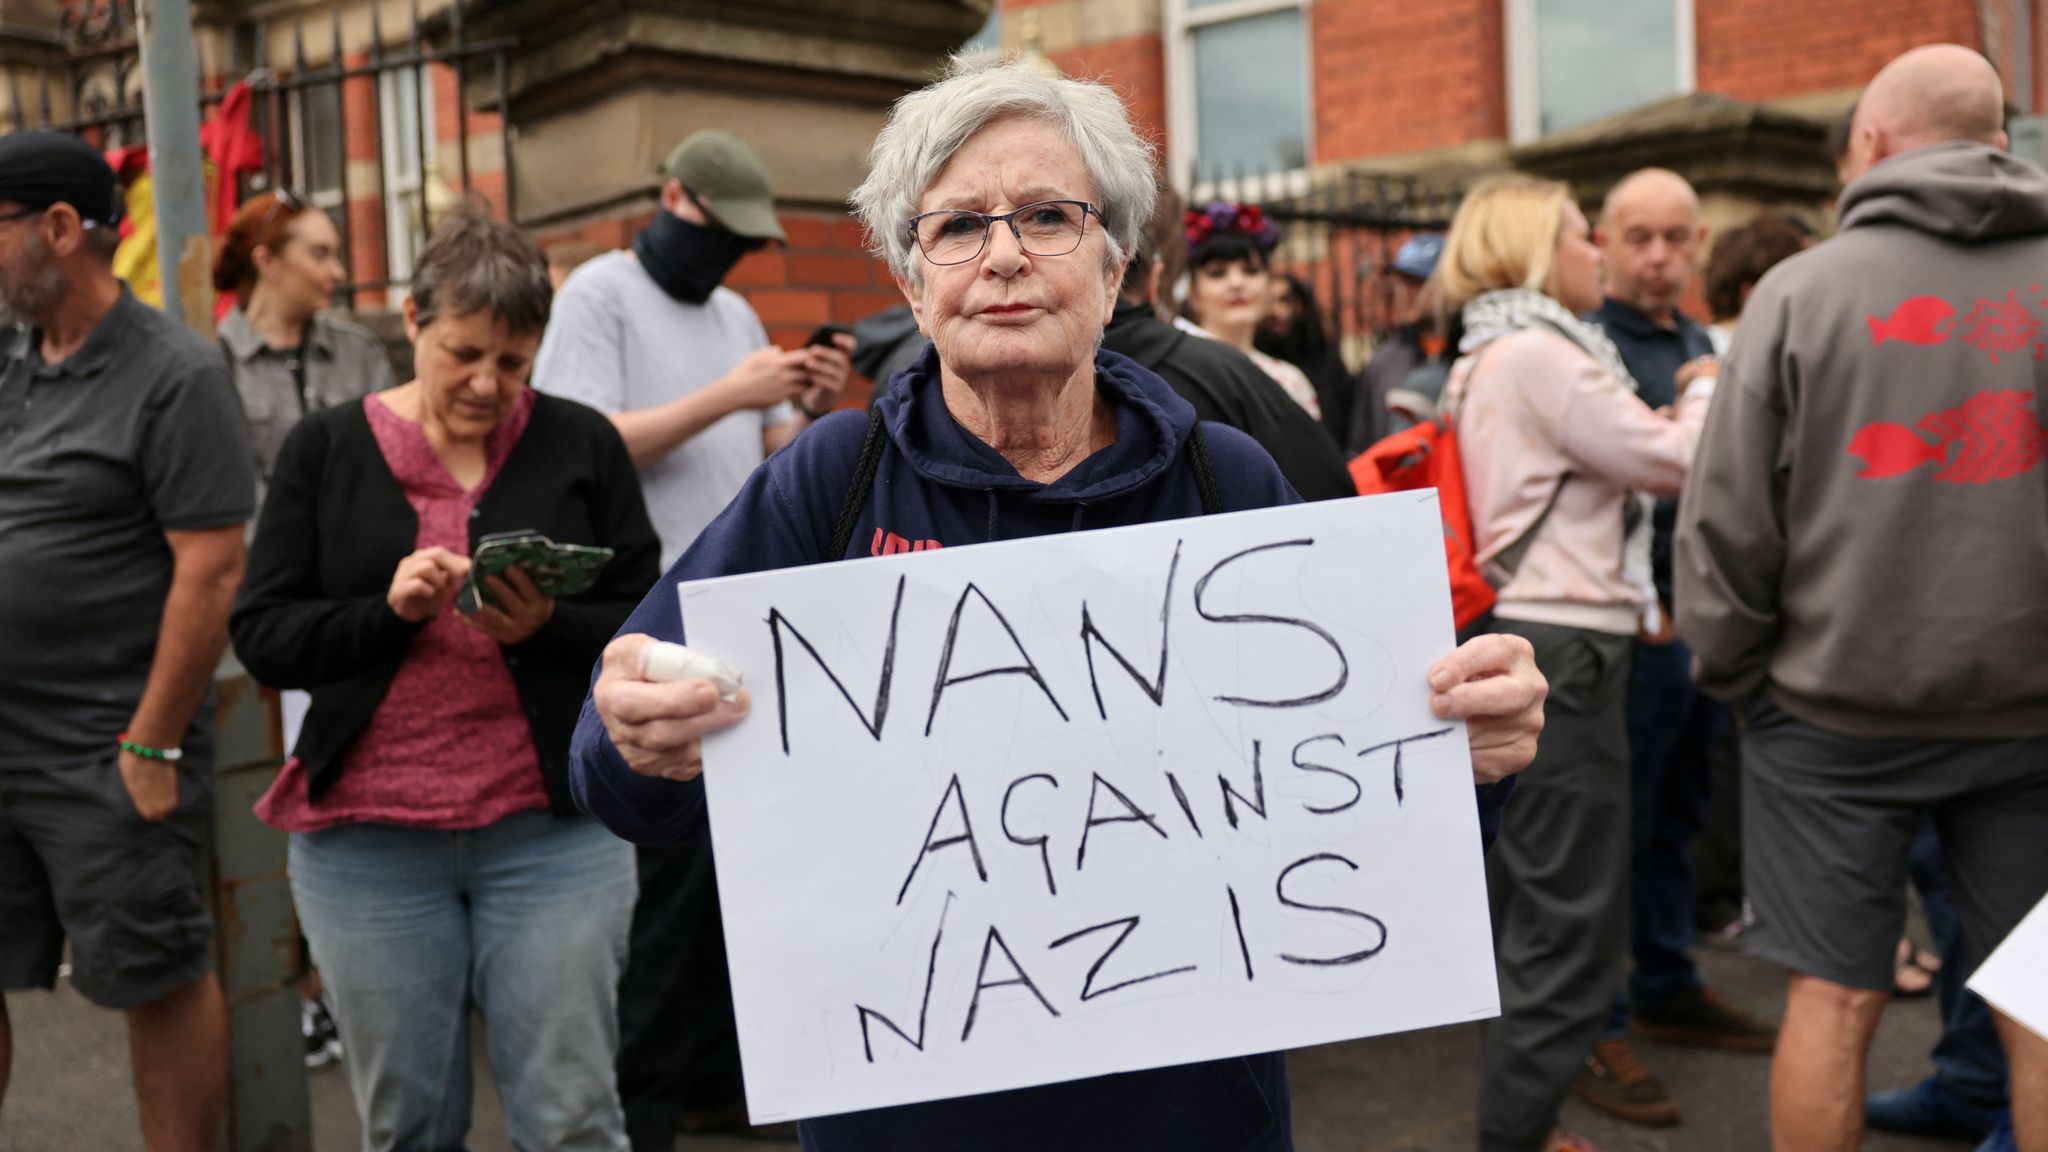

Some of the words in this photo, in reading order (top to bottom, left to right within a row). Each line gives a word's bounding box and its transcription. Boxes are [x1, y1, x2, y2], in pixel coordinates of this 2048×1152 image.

[765, 539, 1349, 755] NANS
[897, 727, 1455, 906] AGAINST
[855, 853, 1387, 1063] NAZIS
